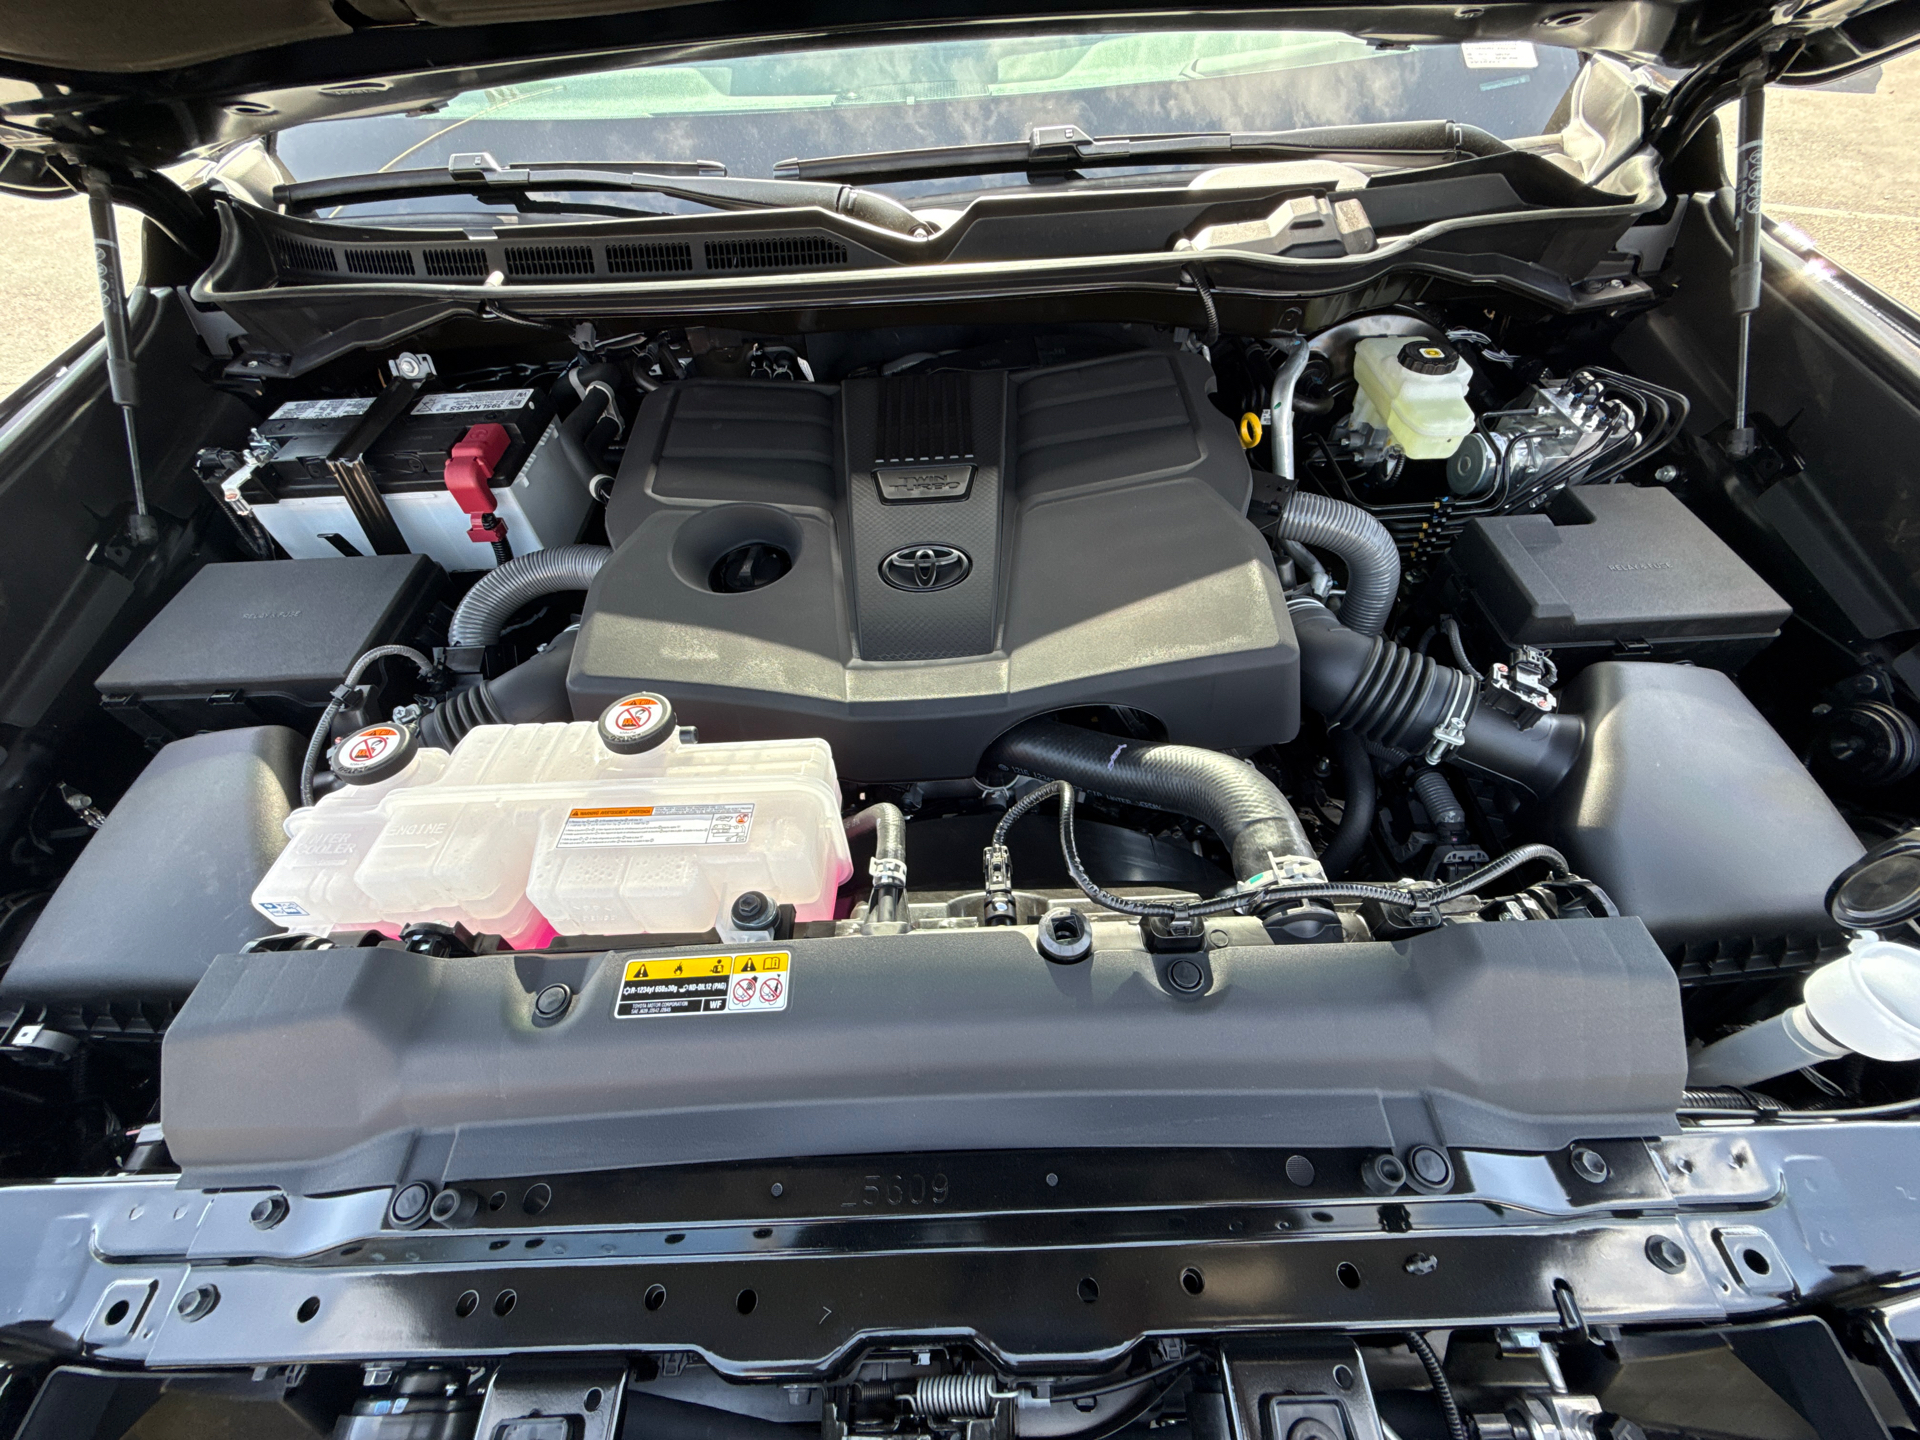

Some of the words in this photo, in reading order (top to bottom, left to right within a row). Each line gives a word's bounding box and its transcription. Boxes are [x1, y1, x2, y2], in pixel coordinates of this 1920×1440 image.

[898, 474, 948, 483] TWIN
[889, 481, 961, 491] TURBO
[388, 823, 447, 835] ENGINE
[296, 843, 356, 855] COOLER
[631, 986, 654, 994] R-1234yf
[712, 982, 727, 991] (PAG)
[710, 1000, 722, 1008] WF
